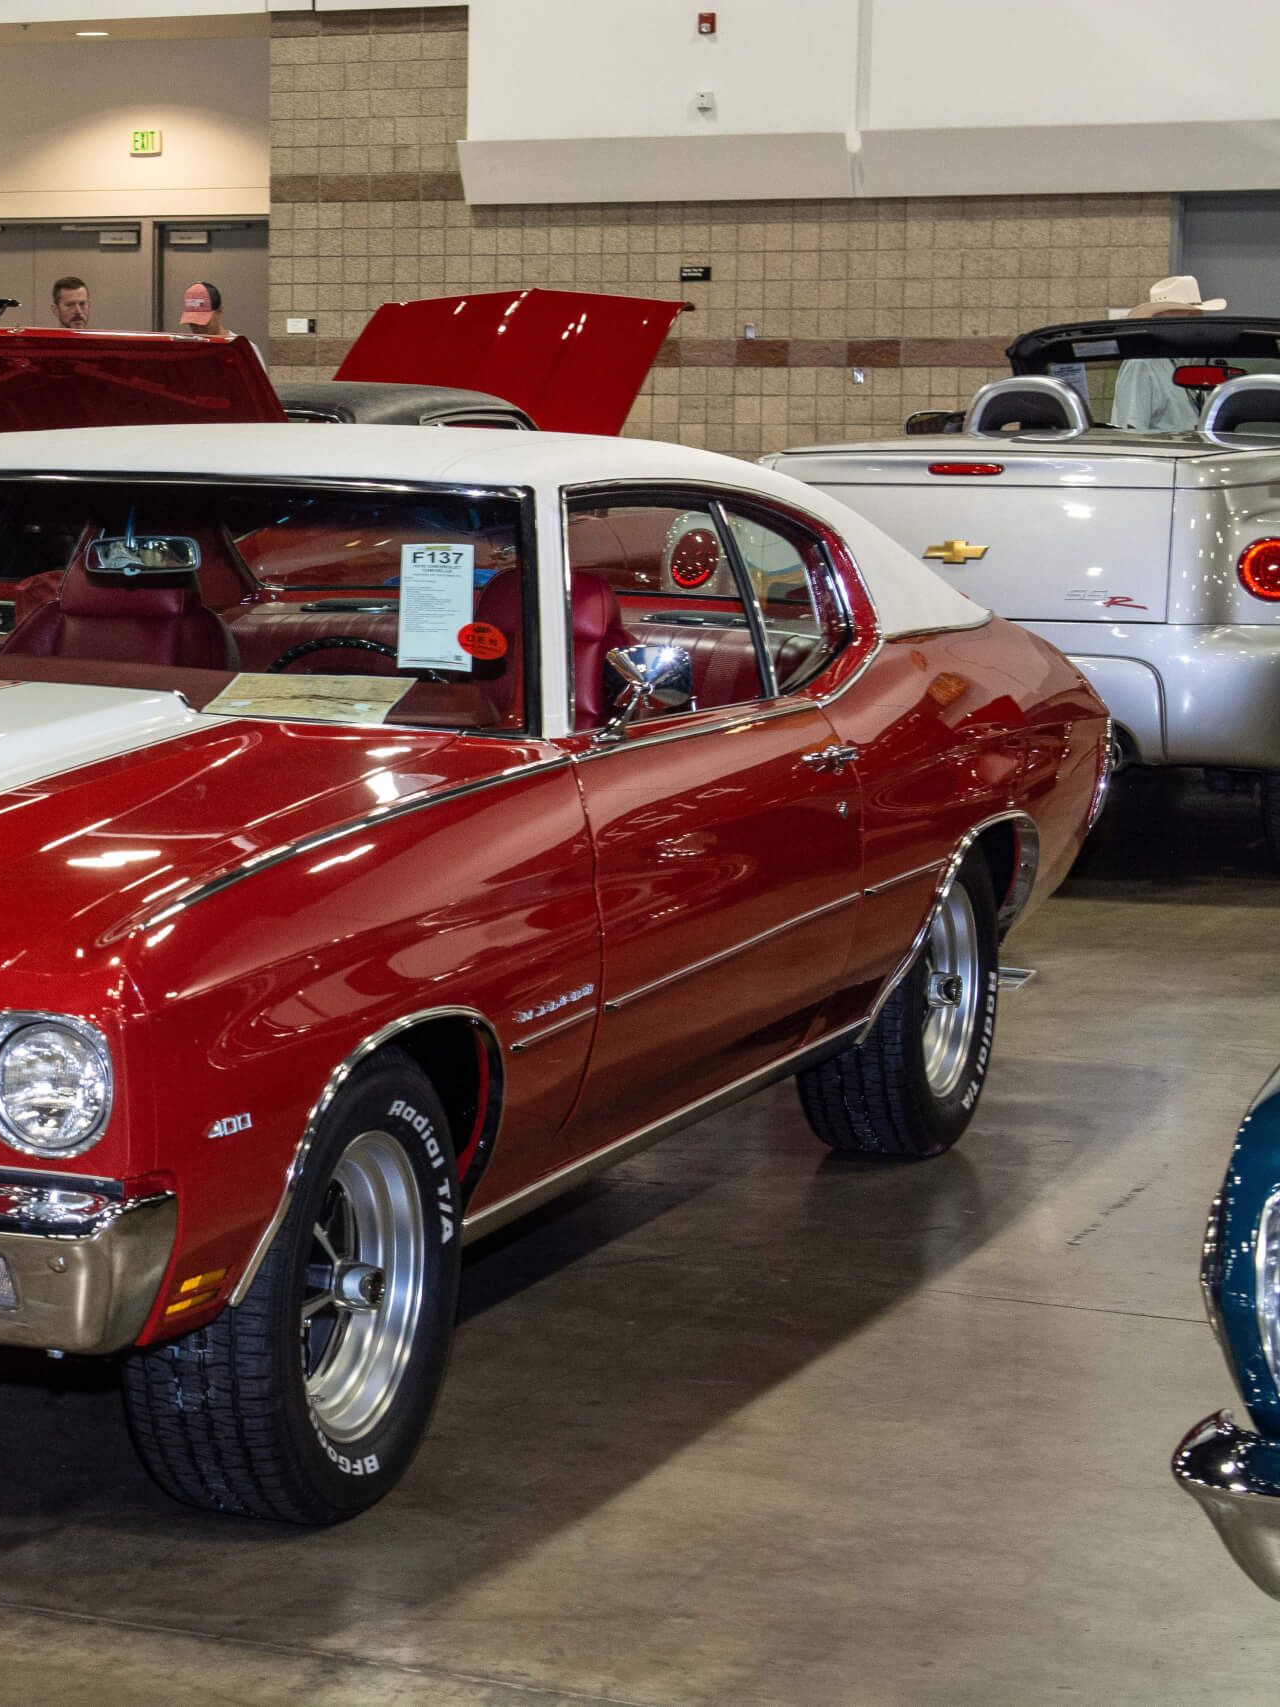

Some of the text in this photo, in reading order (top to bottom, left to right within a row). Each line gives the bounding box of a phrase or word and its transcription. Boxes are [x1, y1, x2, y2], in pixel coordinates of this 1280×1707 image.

[133, 131, 156, 151] EXIT
[412, 551, 464, 565] F137
[207, 1112, 252, 1139] 400
[387, 1099, 455, 1244] Radial T/A
